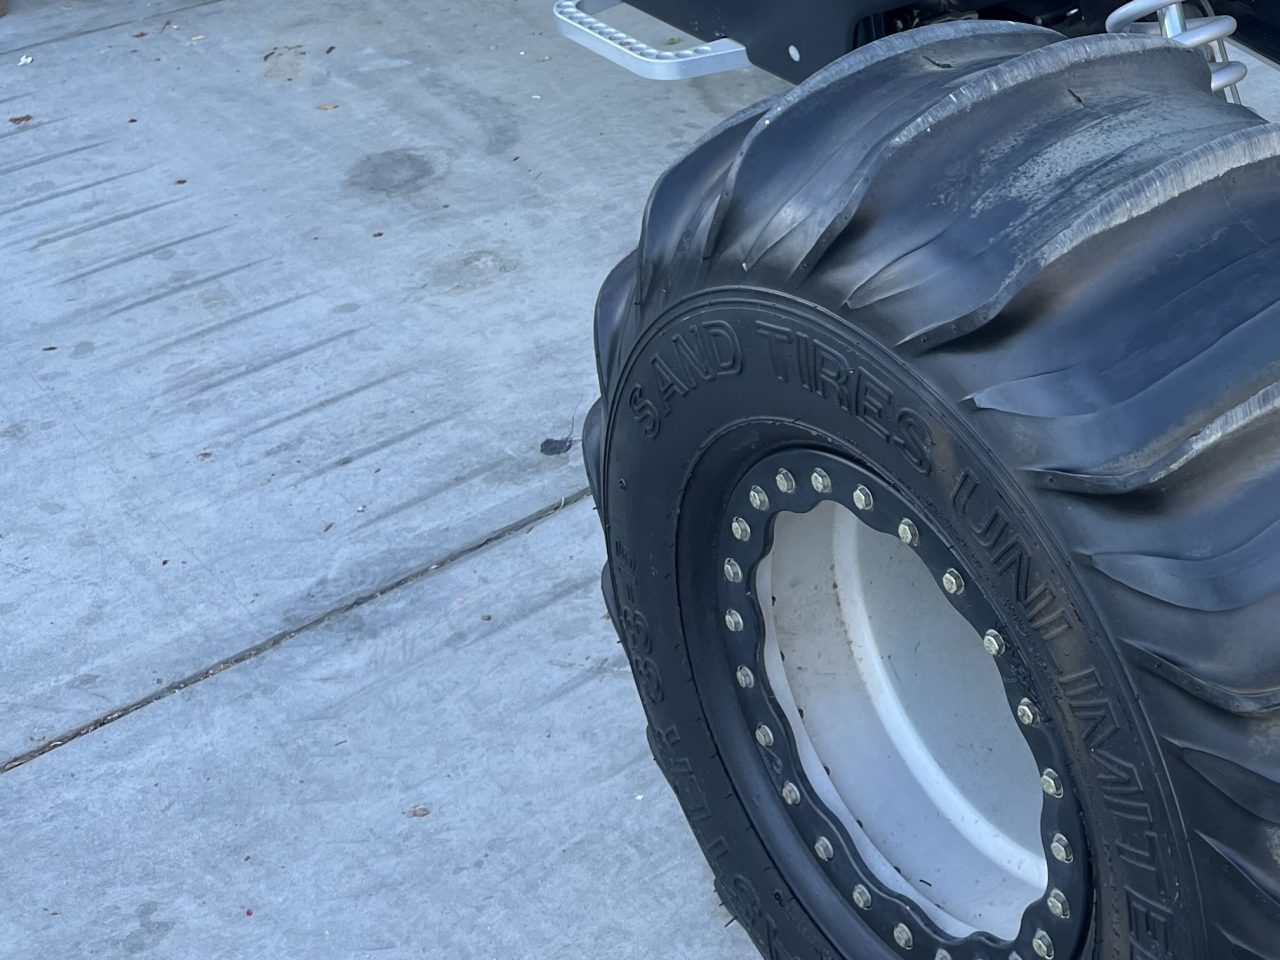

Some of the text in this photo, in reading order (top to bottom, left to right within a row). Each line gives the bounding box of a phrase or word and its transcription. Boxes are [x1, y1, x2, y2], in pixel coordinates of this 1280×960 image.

[629, 319, 1173, 959] SAND TIRES UNLIMITE
